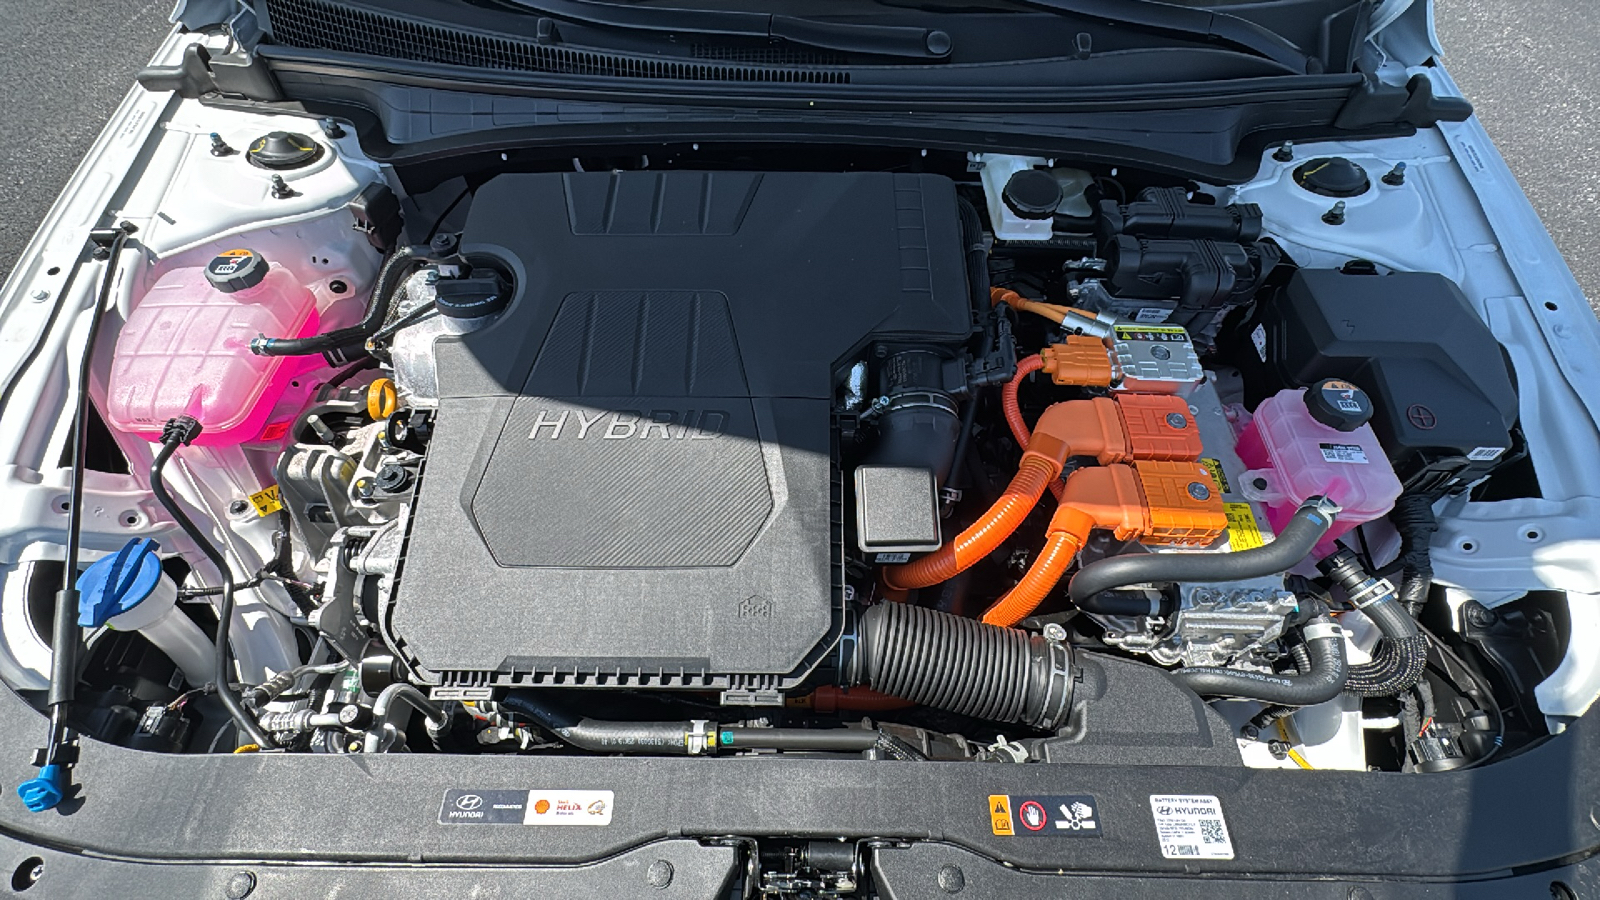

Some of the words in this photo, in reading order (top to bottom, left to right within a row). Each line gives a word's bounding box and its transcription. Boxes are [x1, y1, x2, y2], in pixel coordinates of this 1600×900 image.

[527, 409, 731, 441] HYBRID
[556, 803, 582, 811] HELIX
[1175, 807, 1216, 815] HYUNDAI
[1163, 845, 1177, 855] 12
